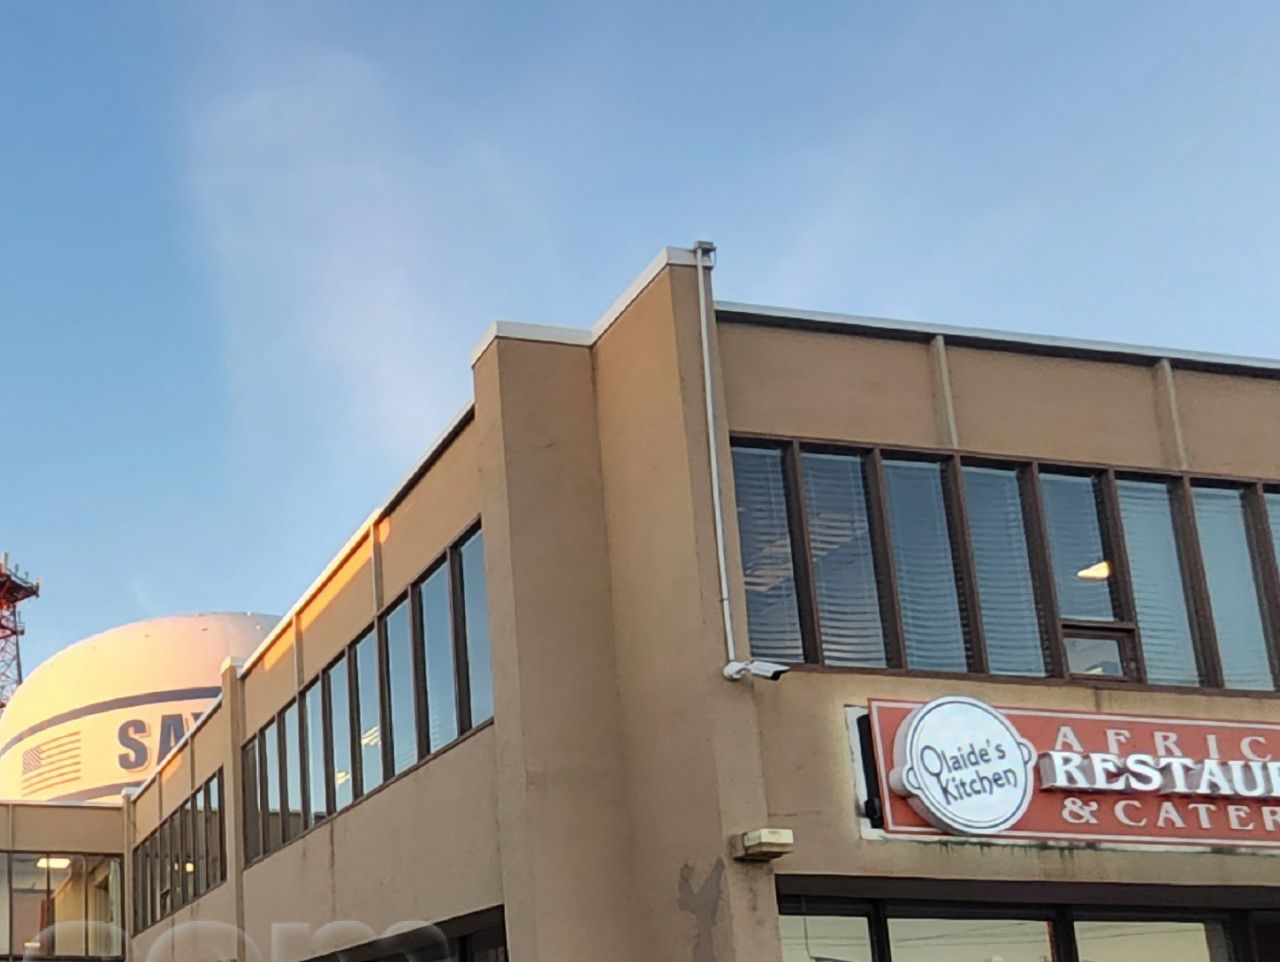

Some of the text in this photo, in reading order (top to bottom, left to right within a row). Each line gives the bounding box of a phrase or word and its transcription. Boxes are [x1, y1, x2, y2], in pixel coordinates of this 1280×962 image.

[118, 712, 204, 769] SA
[920, 738, 1007, 777] Olaide's
[937, 768, 1018, 806] Kitchen
[1061, 797, 1099, 825] &
